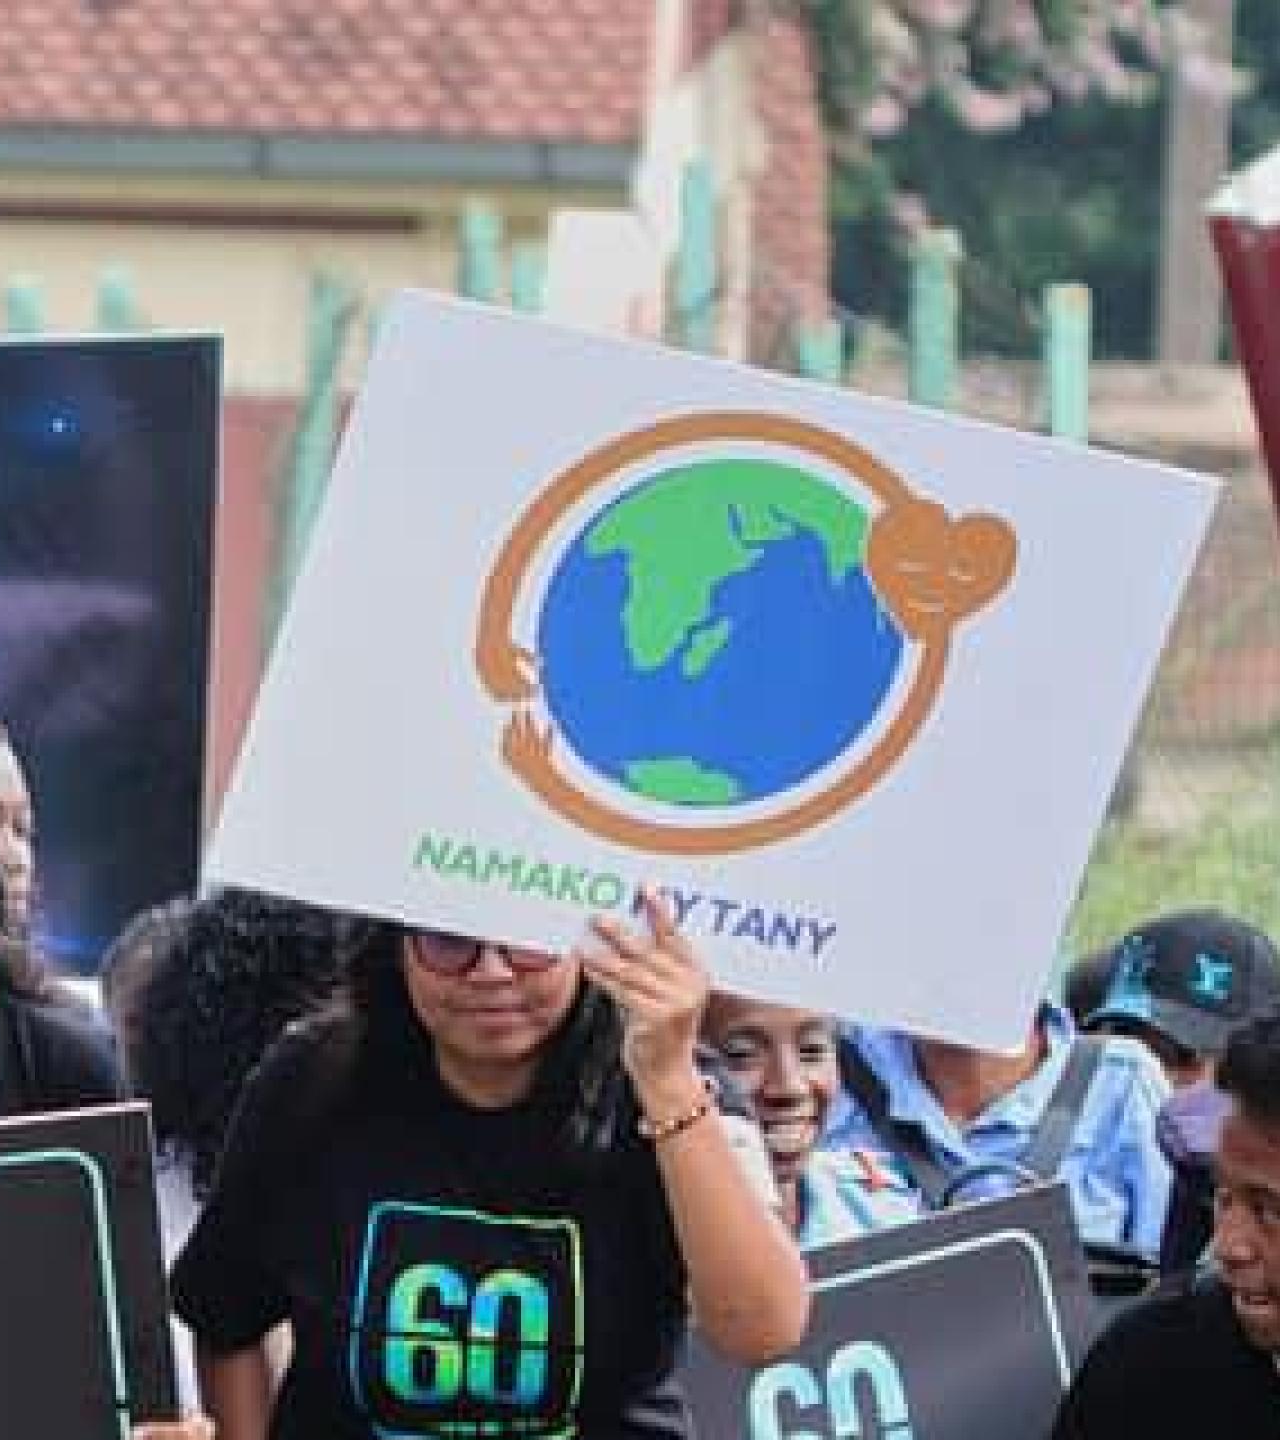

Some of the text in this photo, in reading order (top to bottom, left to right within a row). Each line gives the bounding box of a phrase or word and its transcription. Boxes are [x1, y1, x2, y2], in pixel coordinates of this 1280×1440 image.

[412, 832, 625, 909] NAMAKO
[710, 898, 837, 957] TANY
[385, 1264, 549, 1405] 60
